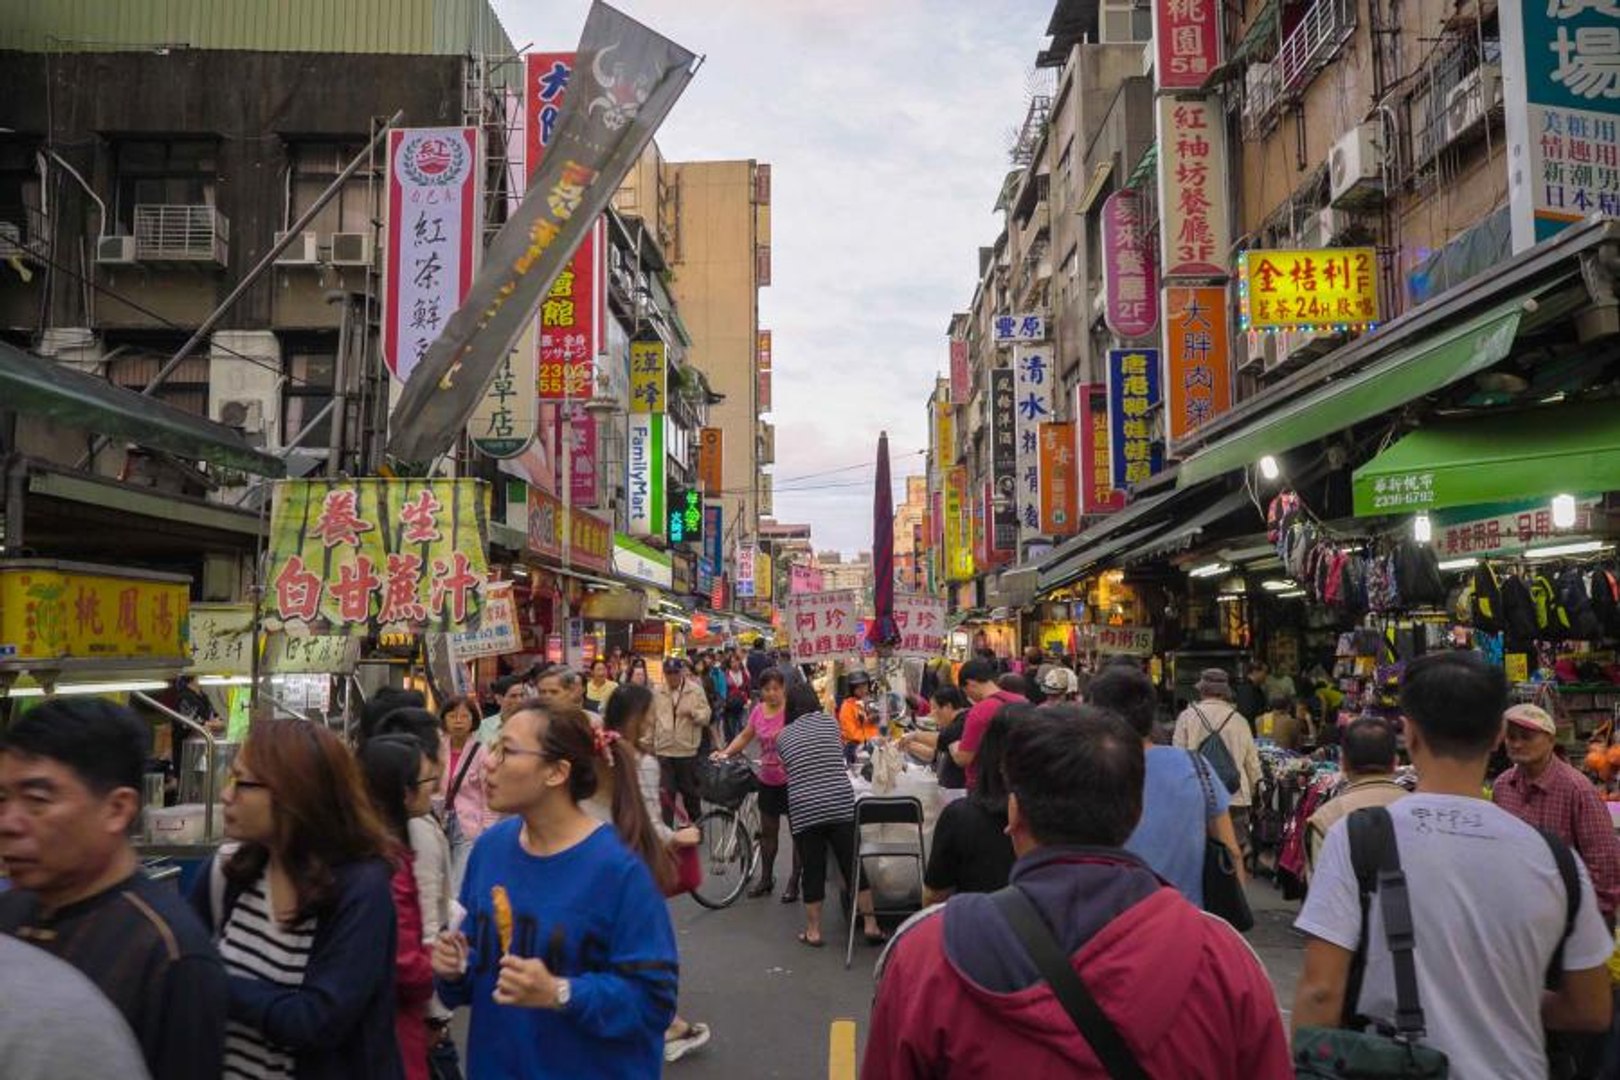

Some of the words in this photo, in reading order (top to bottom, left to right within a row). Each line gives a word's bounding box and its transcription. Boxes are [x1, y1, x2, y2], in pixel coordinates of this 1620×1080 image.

[1168, 0, 1206, 54] 桃園
[1546, 0, 1620, 99] 場
[1173, 106, 1214, 244] 紅袖坊餐廳
[1178, 246, 1214, 262] 3F
[1253, 255, 1350, 293] 金桔利
[994, 315, 1042, 339] 豐原
[1117, 301, 1146, 319] 2F
[630, 426, 648, 520] FamilyMart
[307, 489, 442, 547] 養生
[275, 552, 480, 624] 白甘蔗汁
[1135, 633, 1149, 649] 15
